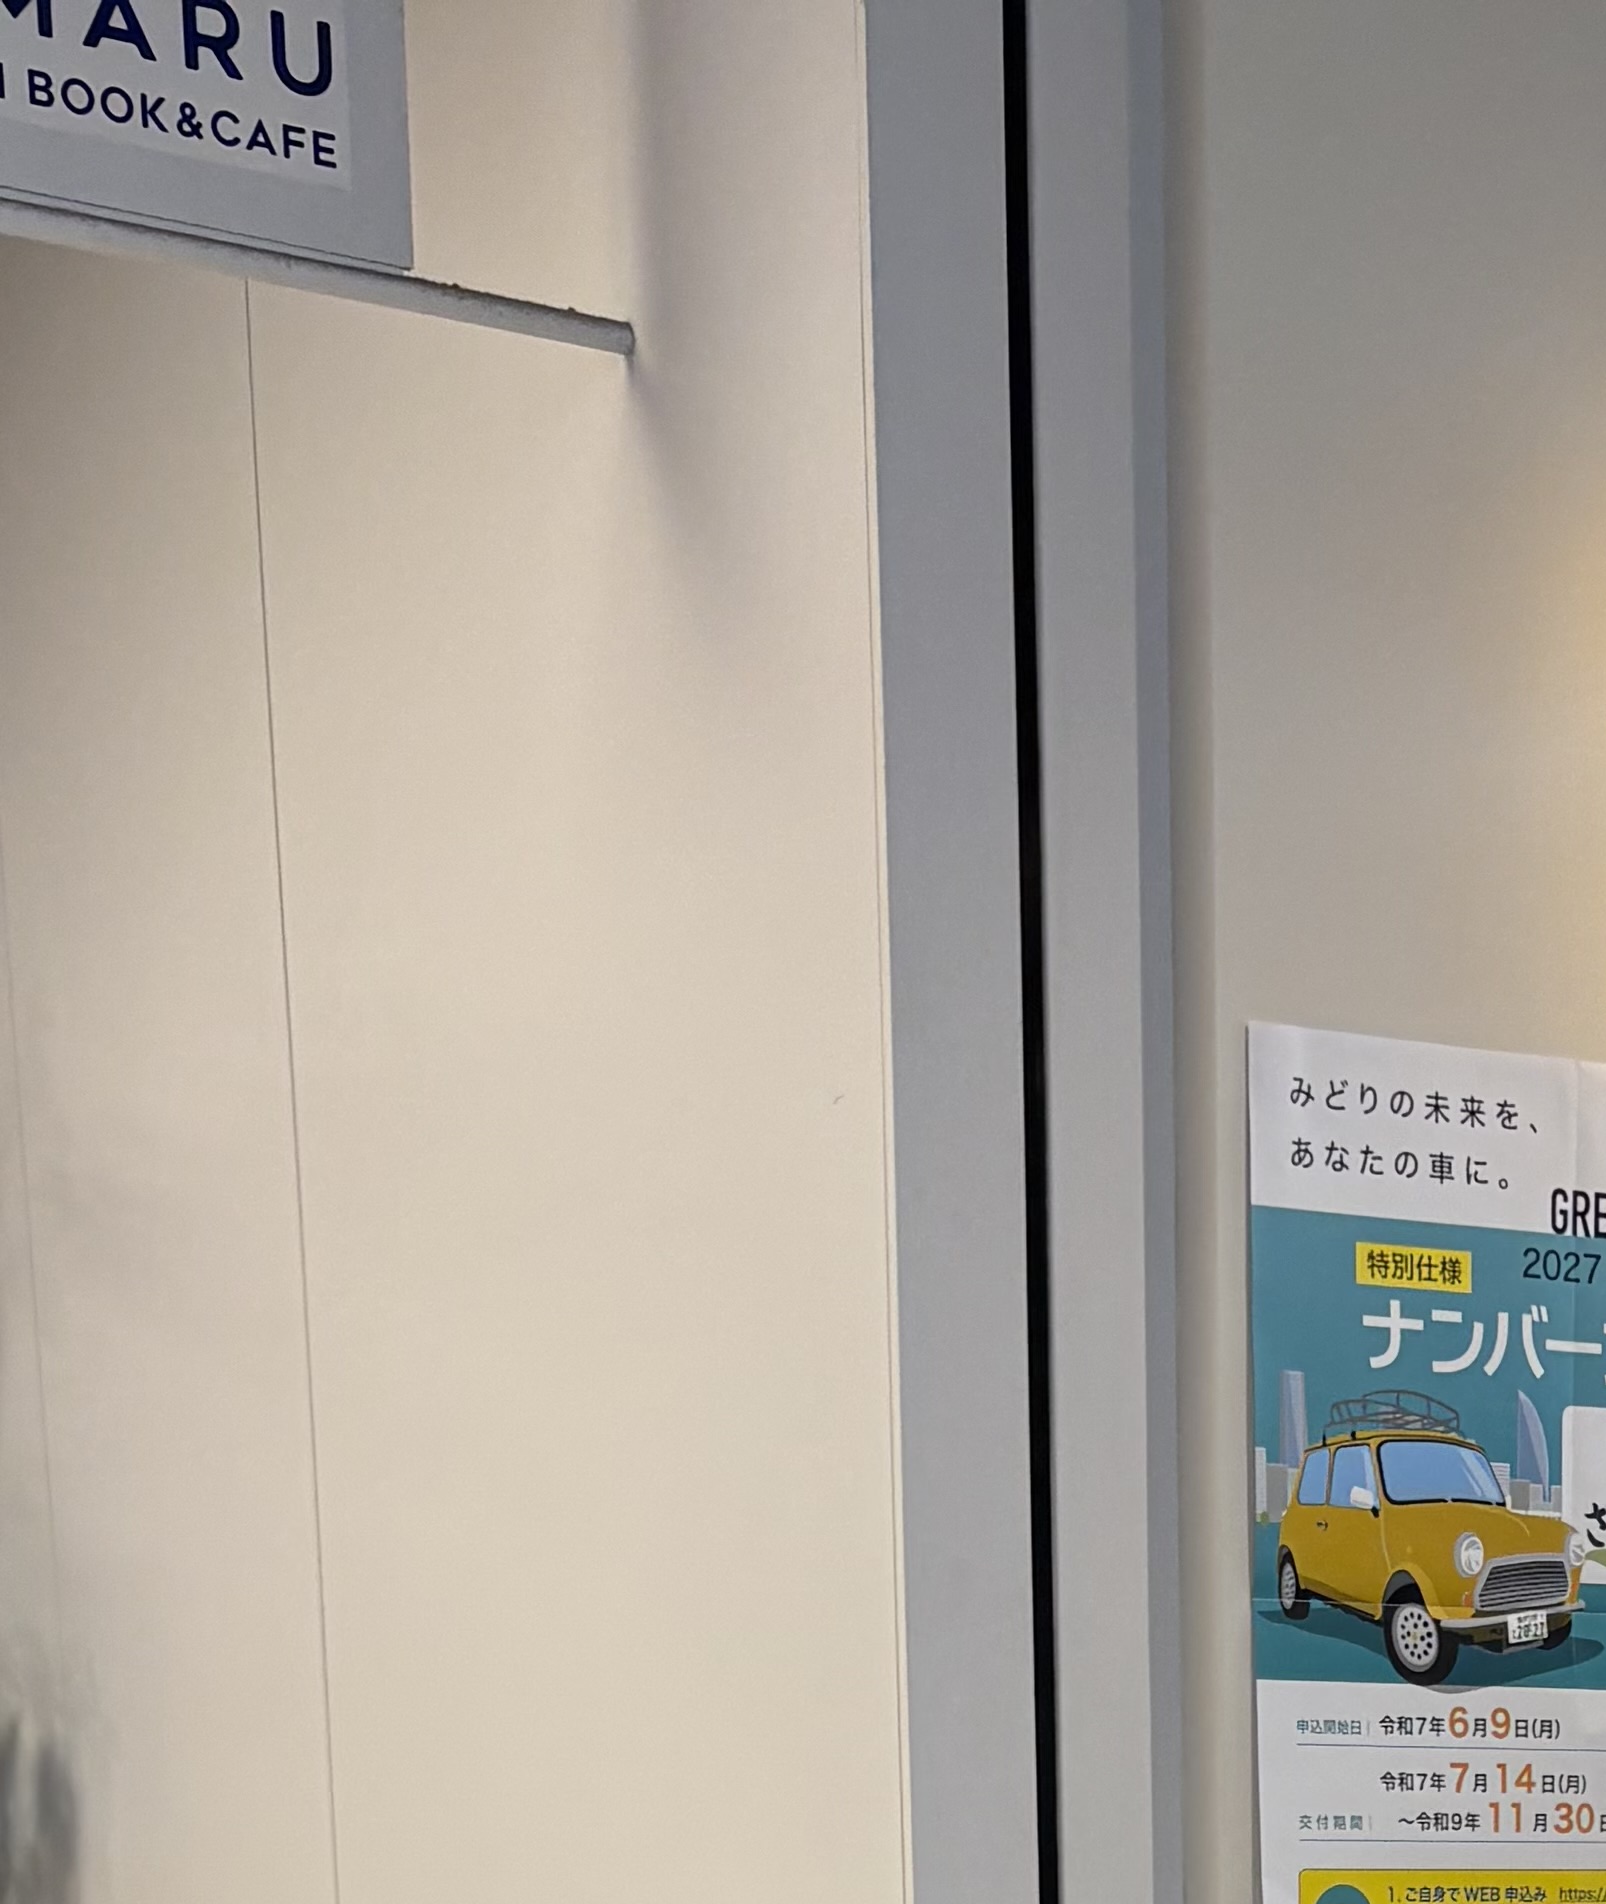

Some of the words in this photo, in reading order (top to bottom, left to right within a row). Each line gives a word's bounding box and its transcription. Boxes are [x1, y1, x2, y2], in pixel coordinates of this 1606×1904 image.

[27, 68, 337, 169] BOOK&CAFE
[1290, 1076, 1540, 1133] みどりの未来を、
[1291, 1137, 1511, 1191] あなたの車に。
[1366, 1250, 1463, 1285] 特別仕様
[1584, 1502, 1606, 1547] さ
[1297, 1719, 1362, 1735] 申込開始日
[1299, 1815, 1363, 1831] 交付期間
[1464, 1886, 1500, 1902] WEB
